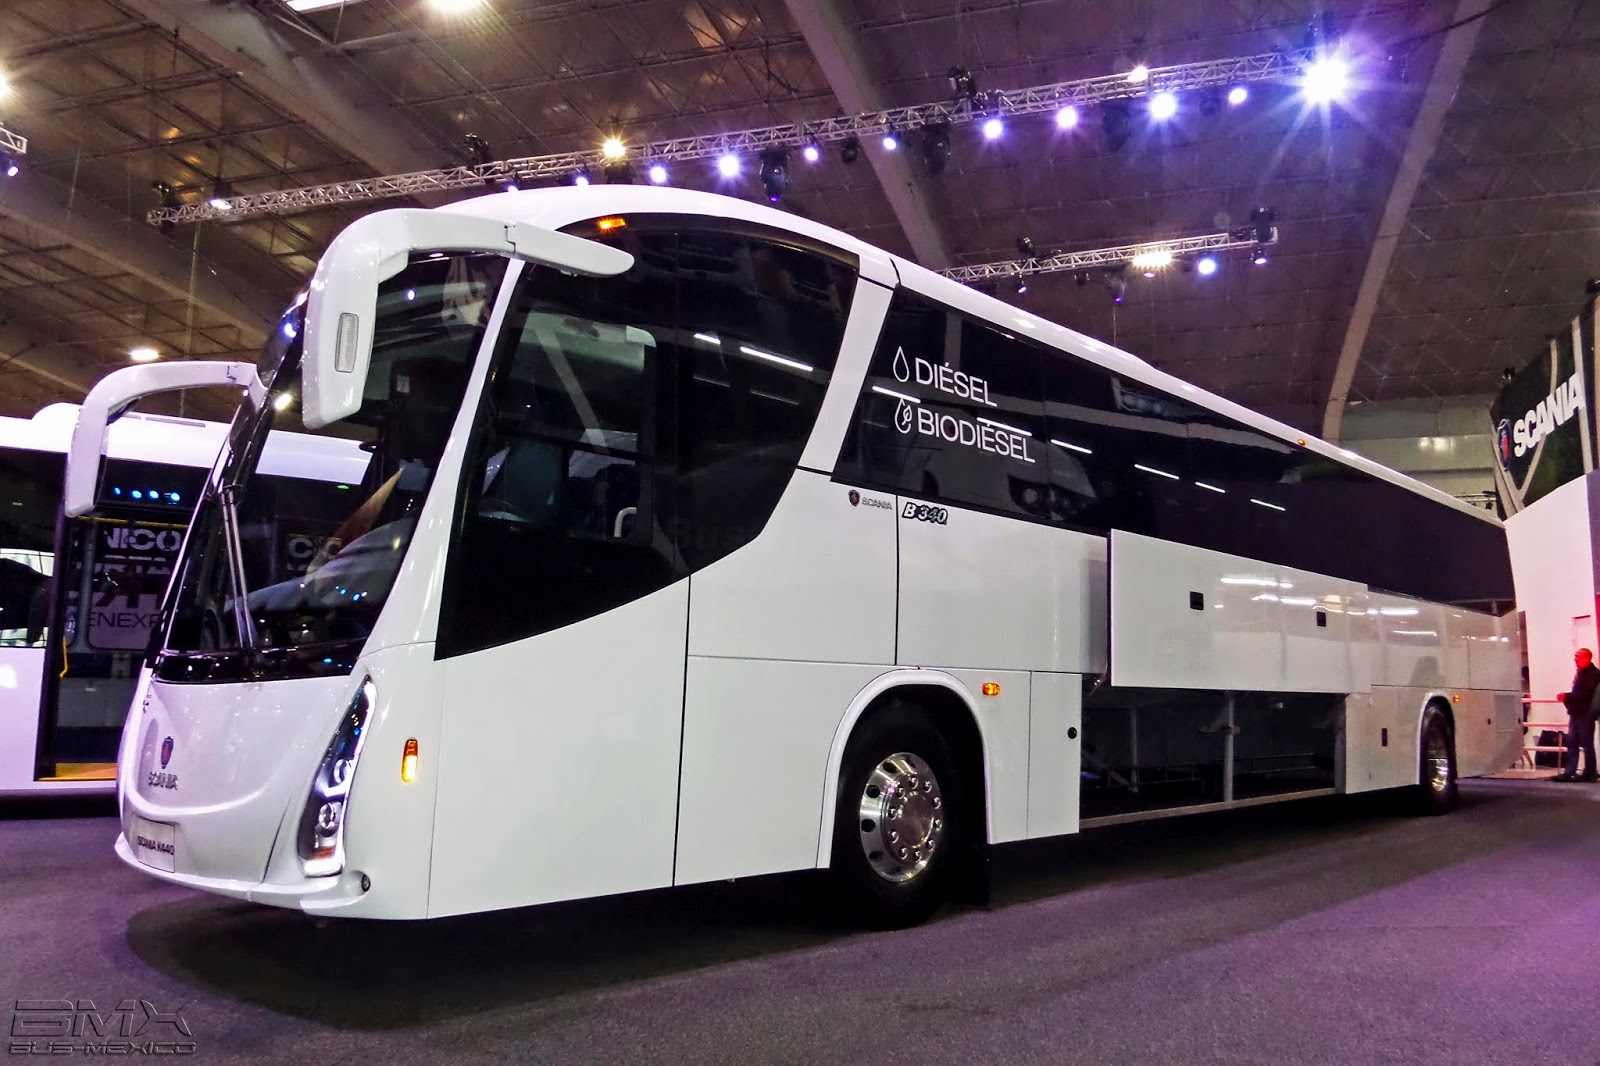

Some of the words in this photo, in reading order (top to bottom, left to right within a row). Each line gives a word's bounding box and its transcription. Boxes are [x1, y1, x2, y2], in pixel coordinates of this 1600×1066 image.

[915, 357, 998, 407] DIÉSEL
[917, 407, 1036, 463] BIODIÉSEL
[1513, 372, 1587, 457] SCANIA
[861, 497, 893, 510] SCANIA
